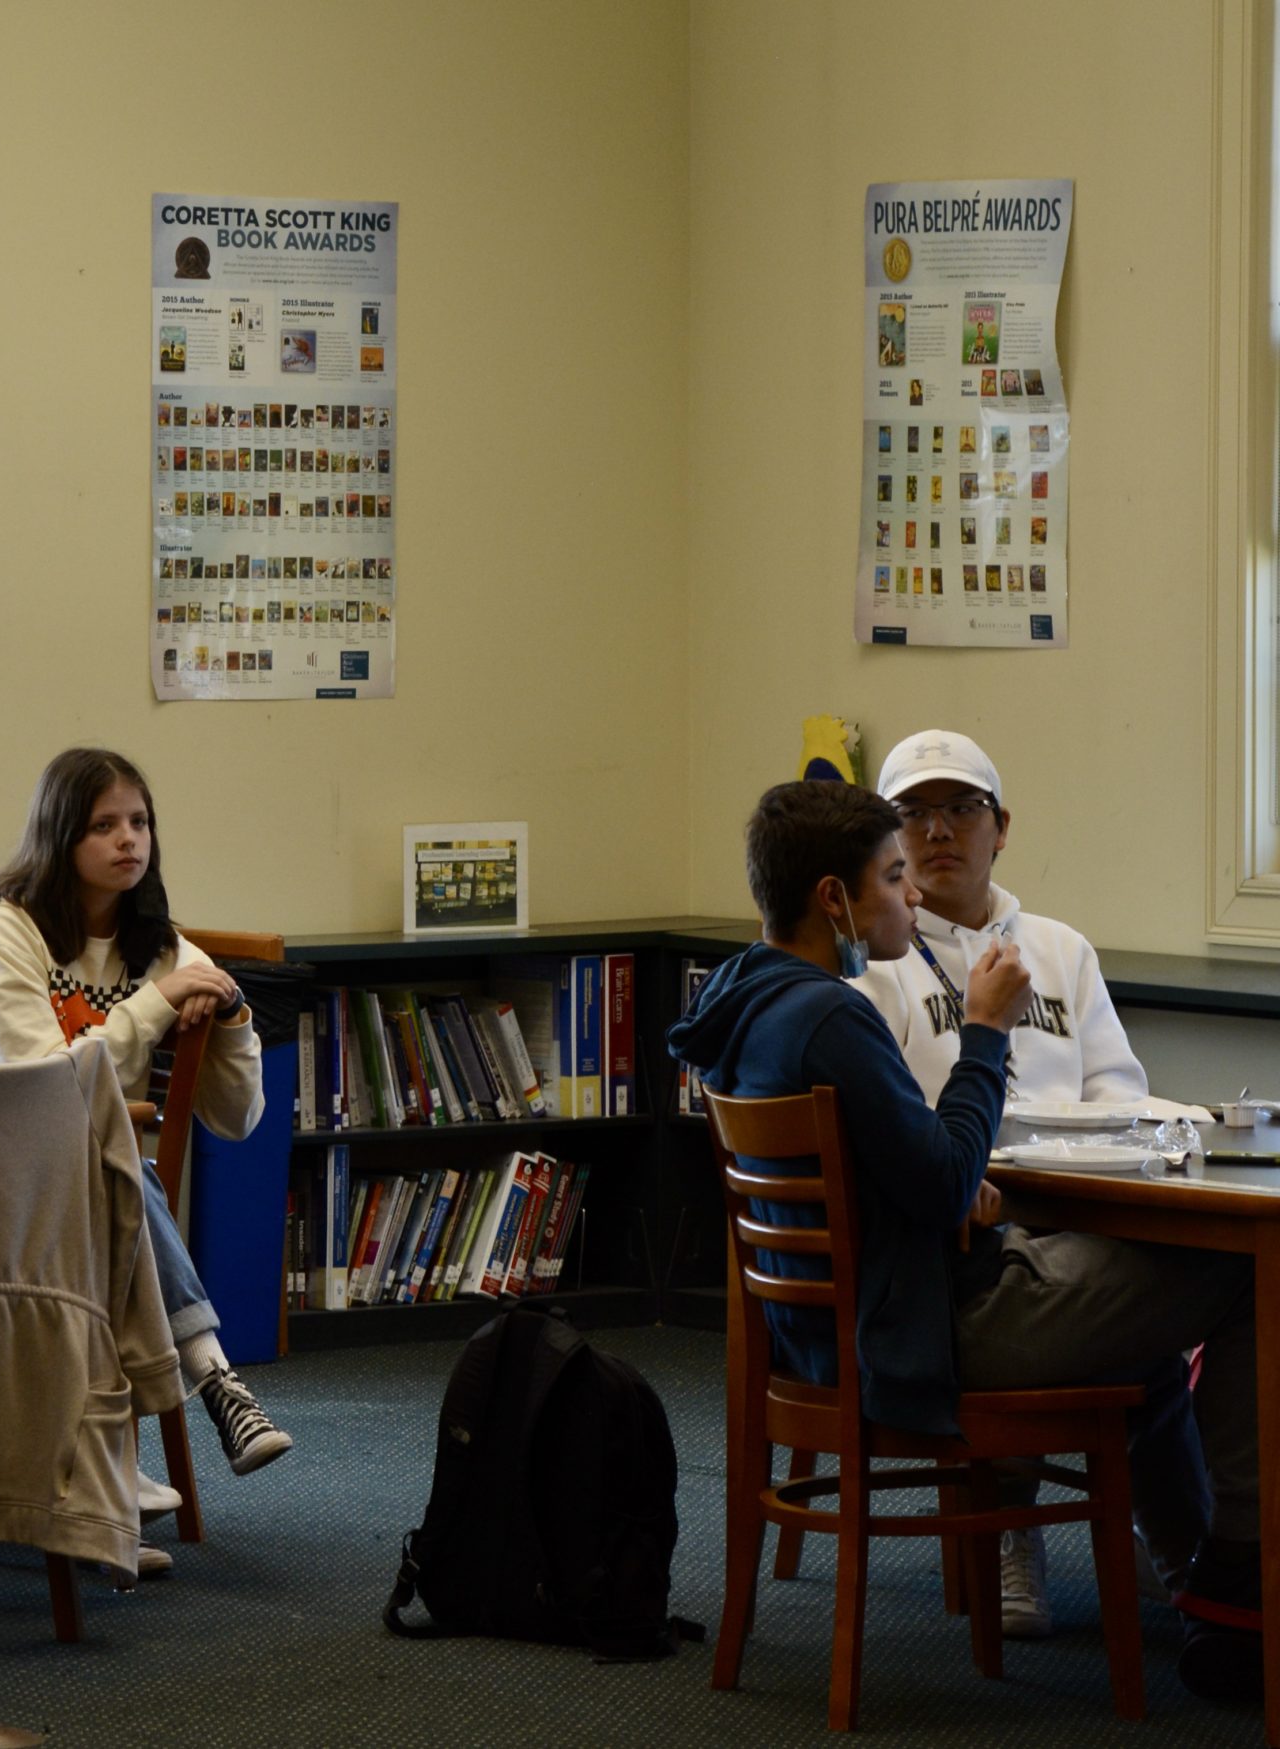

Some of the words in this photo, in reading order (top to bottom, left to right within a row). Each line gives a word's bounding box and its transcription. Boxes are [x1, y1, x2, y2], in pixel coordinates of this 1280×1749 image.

[161, 205, 259, 227] CORETTA
[265, 209, 335, 229] SCOTT
[341, 212, 391, 232] KING
[874, 201, 918, 234] PURA
[923, 190, 980, 233] BELPRÉ
[982, 198, 1062, 231] AWARDS
[217, 229, 277, 249] BOOK
[284, 232, 376, 252] AWARDS
[161, 295, 178, 304] 2015
[180, 296, 205, 304] Author
[282, 299, 299, 307] 2015
[300, 299, 335, 308] Illustrator
[159, 392, 182, 400] Author
